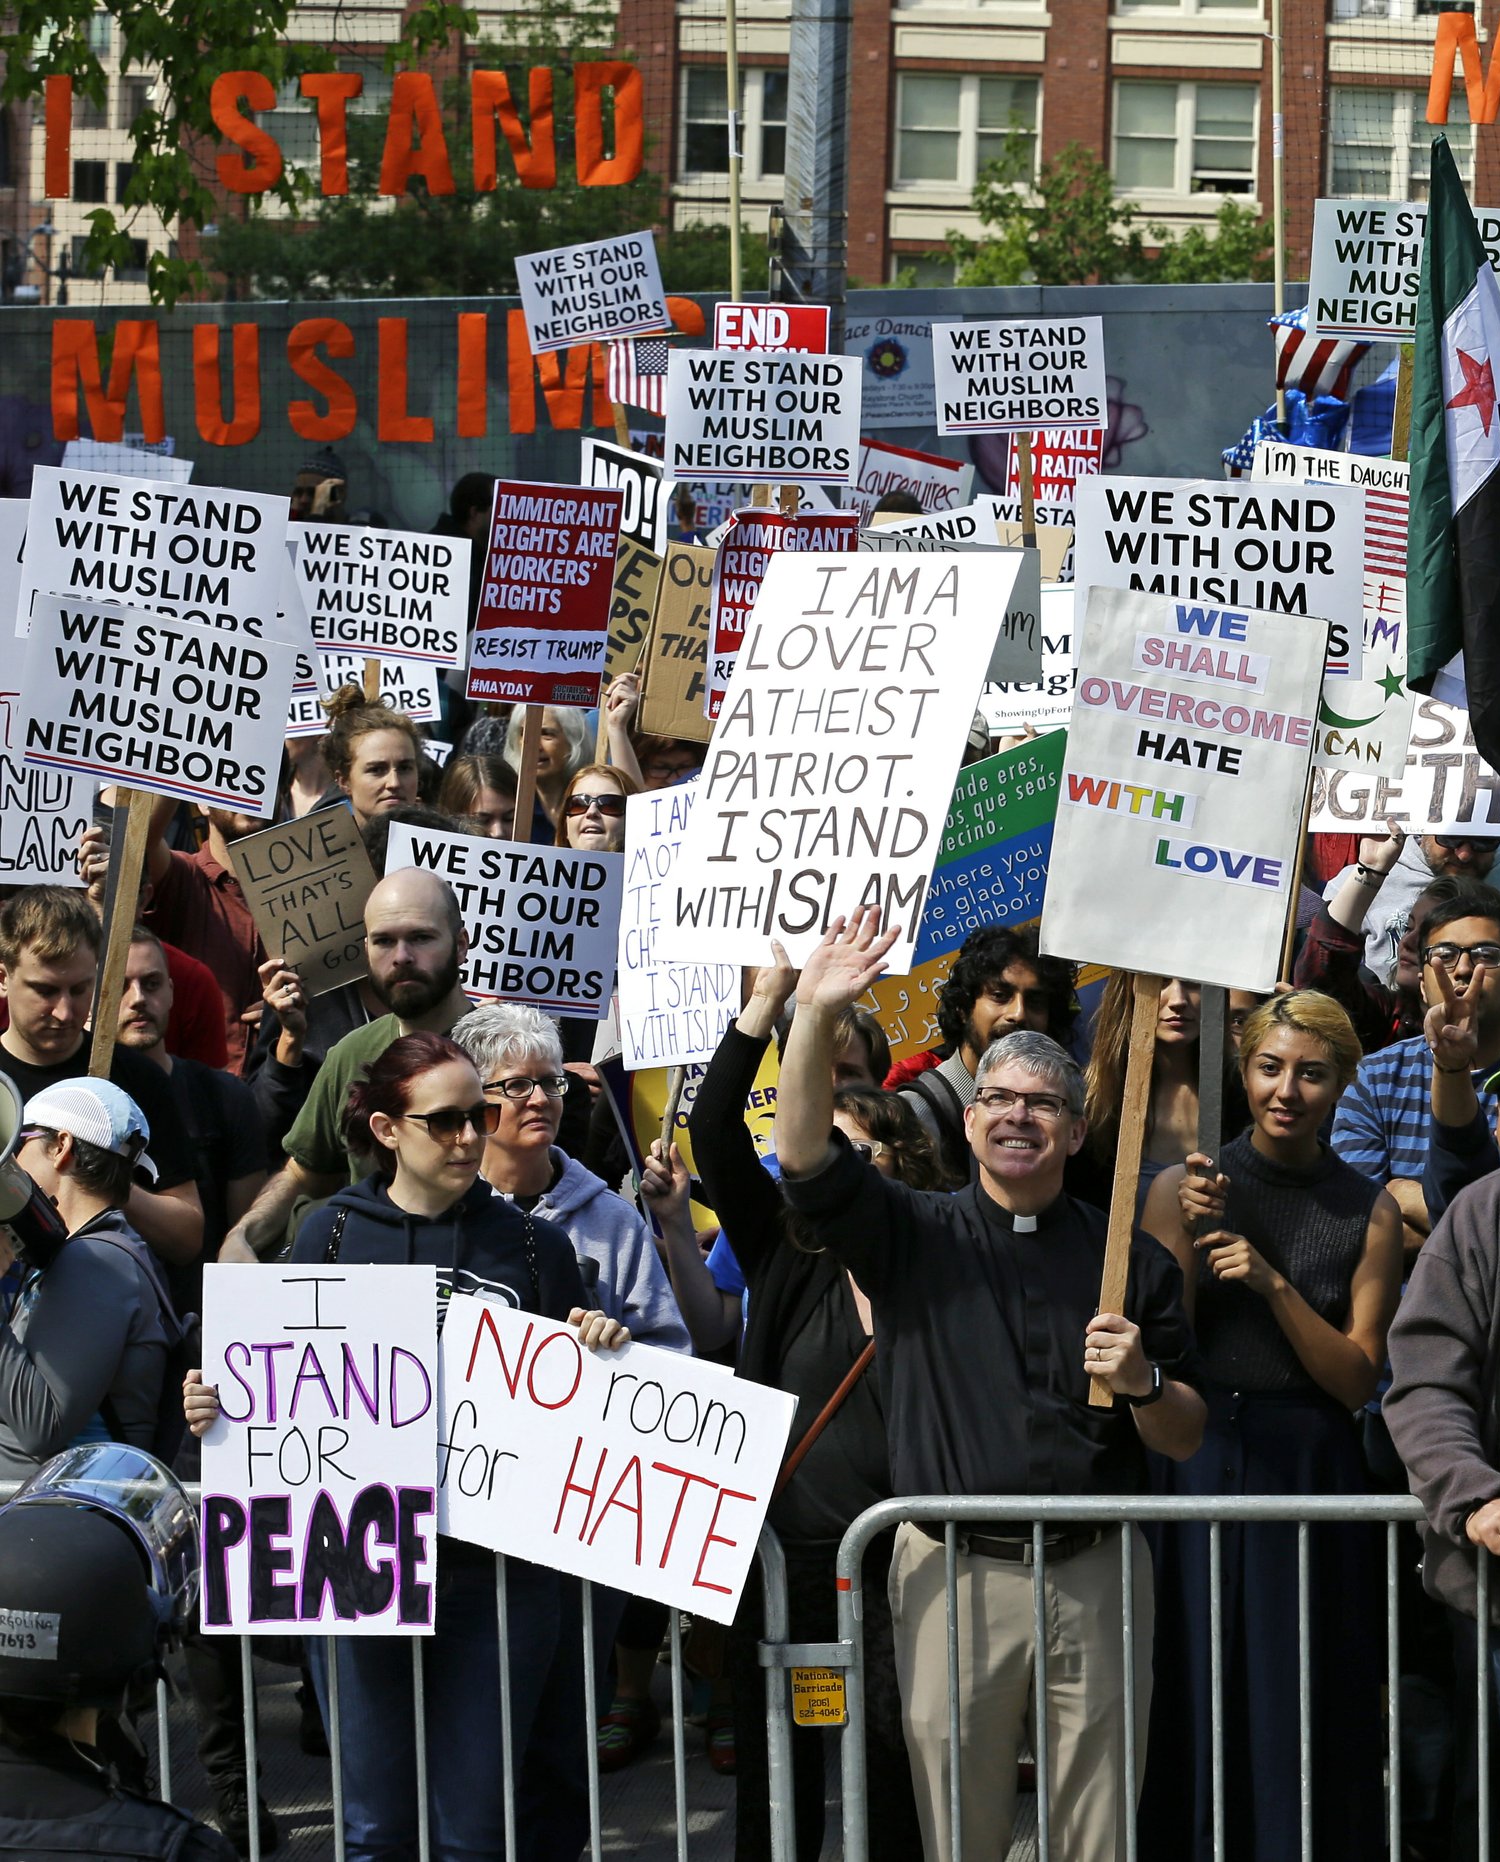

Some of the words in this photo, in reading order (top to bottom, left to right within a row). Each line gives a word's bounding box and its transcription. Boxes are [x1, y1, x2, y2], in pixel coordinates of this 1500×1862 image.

[45, 75, 71, 198] I
[210, 61, 643, 195] STAND
[531, 255, 566, 277] WE
[573, 241, 643, 270] STAND
[535, 273, 594, 298] WITH
[601, 262, 648, 282] OUR
[534, 300, 664, 342] NEIGHBORS
[552, 284, 641, 317] MUSLIM
[719, 307, 790, 347] END
[950, 330, 991, 350] WE
[1000, 326, 1086, 347] STAND
[689, 359, 734, 384] WE
[744, 362, 843, 386] STAND
[951, 353, 1020, 373] WITH
[1028, 350, 1087, 371] OUR
[689, 387, 765, 412] WITH
[775, 390, 842, 415] OUR
[967, 375, 1074, 397] MUSLIM
[703, 416, 823, 442] MUSLIM
[944, 397, 1100, 422] NEIGHBORS
[674, 443, 850, 471] NEIGHBORS
[1045, 431, 1098, 451] WALL
[1041, 454, 1099, 478] RAIDS
[59, 480, 120, 517] WE
[130, 491, 262, 535] STAND
[499, 494, 618, 530] IMMIGRANT
[1105, 489, 1174, 525] WE
[1188, 493, 1336, 533] STAND
[55, 518, 156, 560] WITH
[169, 534, 256, 572] OUR
[304, 531, 352, 557] WE
[359, 537, 452, 568] STAND
[494, 525, 569, 556] RIGHTS
[575, 532, 615, 558] ARE
[1105, 530, 1220, 569] WITH
[1234, 539, 1335, 576] OUR
[70, 558, 229, 606] MUSLIM
[303, 560, 379, 588] WITH
[388, 572, 450, 597] OUR
[484, 583, 561, 615] RIGHTS
[803, 566, 847, 615] I
[846, 567, 920, 619] AM
[923, 565, 959, 617] A
[317, 590, 432, 623] MUSLIM
[1175, 605, 1249, 642] WE
[60, 610, 124, 649] WE
[134, 625, 268, 681] STAND
[475, 639, 538, 661] RESIST
[546, 640, 604, 662] TRUMP
[746, 622, 938, 677] LOVER
[1141, 638, 1258, 684] SHALL
[55, 647, 160, 696] WITH
[172, 674, 261, 720] OUR
[471, 679, 533, 698] #MAYDAY
[69, 689, 232, 752] MUSLIM
[719, 685, 939, 740] ATHEIST
[1080, 677, 1311, 747] OVERCOME
[26, 718, 265, 796] NEIGHBORS
[999, 755, 1045, 786] eres,
[1137, 730, 1242, 775] HATE
[706, 750, 915, 802] PATRIOT.
[974, 793, 1008, 820] que
[1016, 769, 1058, 801] seas
[1068, 773, 1184, 823] WITH
[706, 810, 748, 862] I
[756, 806, 928, 863] STAND
[411, 837, 469, 876] WE
[479, 850, 608, 892] STAND
[926, 863, 993, 900] where
[1002, 841, 1044, 873] you
[1155, 839, 1283, 888] LOVE
[261, 871, 354, 918] THAT'S
[518, 892, 600, 928] OUR
[676, 885, 763, 928] WITH
[762, 868, 928, 943] ISLAM
[956, 876, 1004, 915] glad
[281, 901, 365, 954] ALL
[930, 892, 1040, 947] neighbor.
[668, 963, 735, 1015] STAND
[627, 1016, 680, 1061] WITH
[281, 1277, 346, 1330] I
[217, 1341, 432, 1429] STAND
[465, 1307, 583, 1410] NO
[602, 1371, 747, 1464] room
[246, 1426, 356, 1488] FOR
[437, 1399, 519, 1501] for
[553, 1436, 757, 1594] HATE
[202, 1482, 435, 1627] PEACE
[793, 1682, 842, 1694] Barricade
